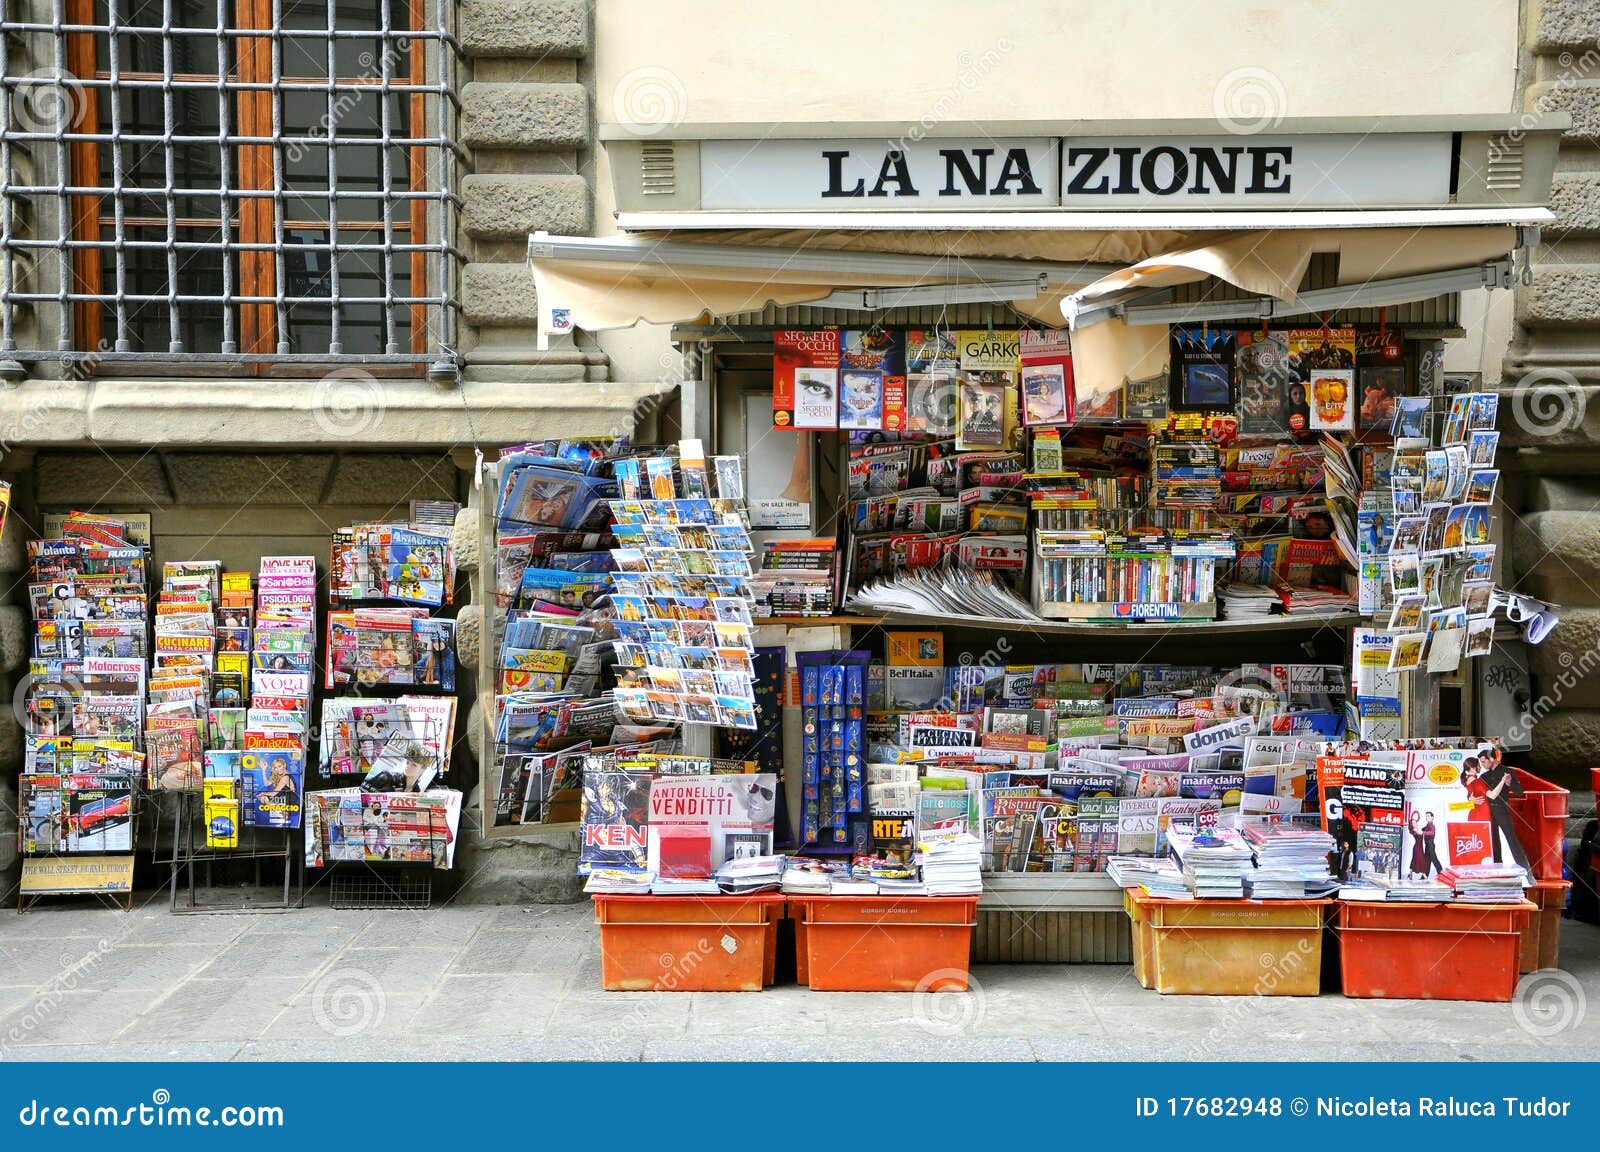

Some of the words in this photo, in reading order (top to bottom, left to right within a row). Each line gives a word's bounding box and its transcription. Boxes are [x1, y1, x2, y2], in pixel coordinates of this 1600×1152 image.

[821, 151, 919, 197] LA
[939, 149, 1042, 195] NA
[1067, 146, 1292, 195] ZIONE
[784, 331, 836, 341] SEGRETO
[978, 334, 1014, 342] GABRIEL
[797, 341, 835, 351] OCCHI
[261, 594, 312, 606] PSICOLOGIA
[1132, 604, 1178, 617] FIORENTINA
[158, 638, 209, 647] CUCINARE
[88, 661, 141, 673] Motocross
[889, 669, 934, 679] Bell'Italia
[1291, 667, 1324, 682] VELA
[261, 677, 303, 694] yoga
[1301, 682, 1329, 694] barche
[253, 697, 284, 708] RIZA
[407, 705, 446, 714] ncinetto
[927, 730, 968, 740] CUCINA
[1190, 722, 1251, 749] domus
[247, 736, 299, 749] Dimagrire
[917, 737, 967, 746] ITALIANA
[1215, 776, 1244, 785] claire
[1345, 768, 1387, 781] ALIANO
[1052, 776, 1082, 785] marie
[1085, 776, 1113, 786] claire
[653, 786, 725, 799] ANTONELLO
[653, 799, 732, 816] VENDITTI
[1121, 817, 1156, 832] CAS
[586, 824, 648, 847] KEN
[1456, 834, 1483, 854] Ballo
[25, 866, 37, 875] THE
[39, 866, 55, 875] WALL
[56, 865, 79, 875] STREET
[79, 864, 105, 874] JOURNAL
[107, 864, 129, 873] EUROPE
